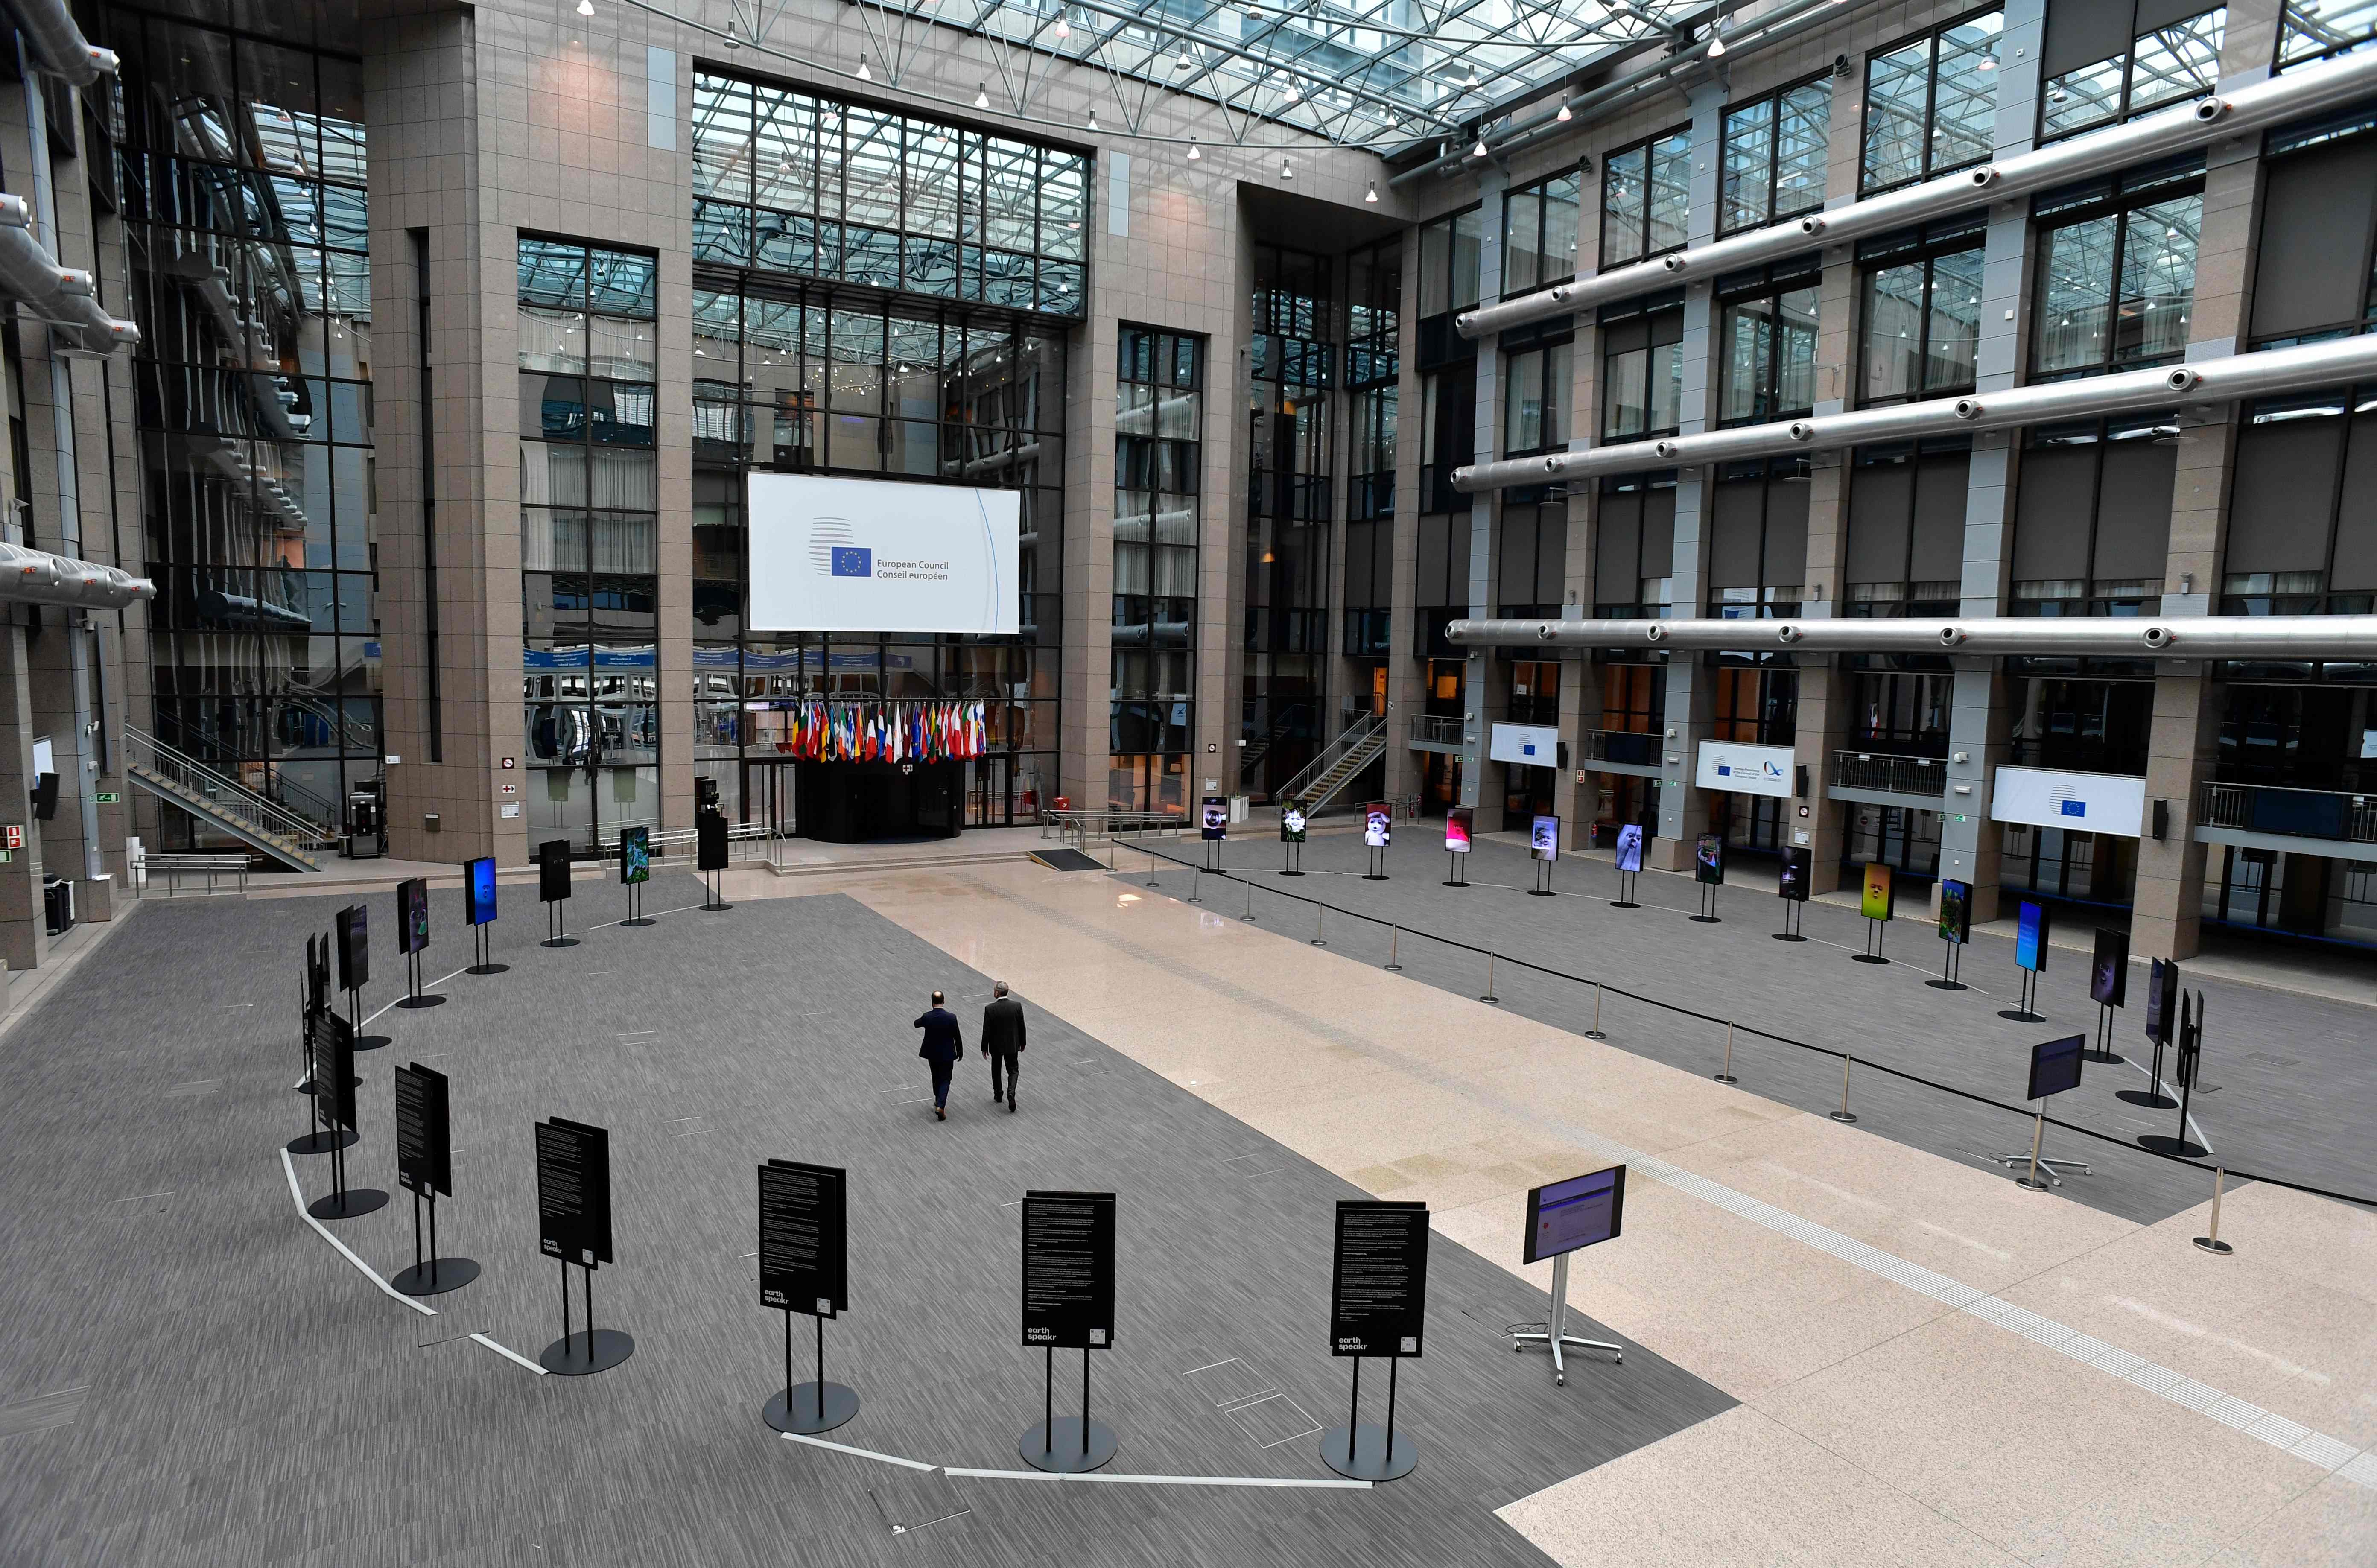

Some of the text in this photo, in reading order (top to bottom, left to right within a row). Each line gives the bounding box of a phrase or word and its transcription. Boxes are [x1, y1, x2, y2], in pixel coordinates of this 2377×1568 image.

[877, 559, 949, 569] European Council
[877, 570, 948, 581] Conseil européen
[544, 1244, 562, 1253] speakr
[765, 1289, 783, 1297] earth
[765, 1295, 789, 1305] speakr
[1338, 1343, 1368, 1351] speakr
